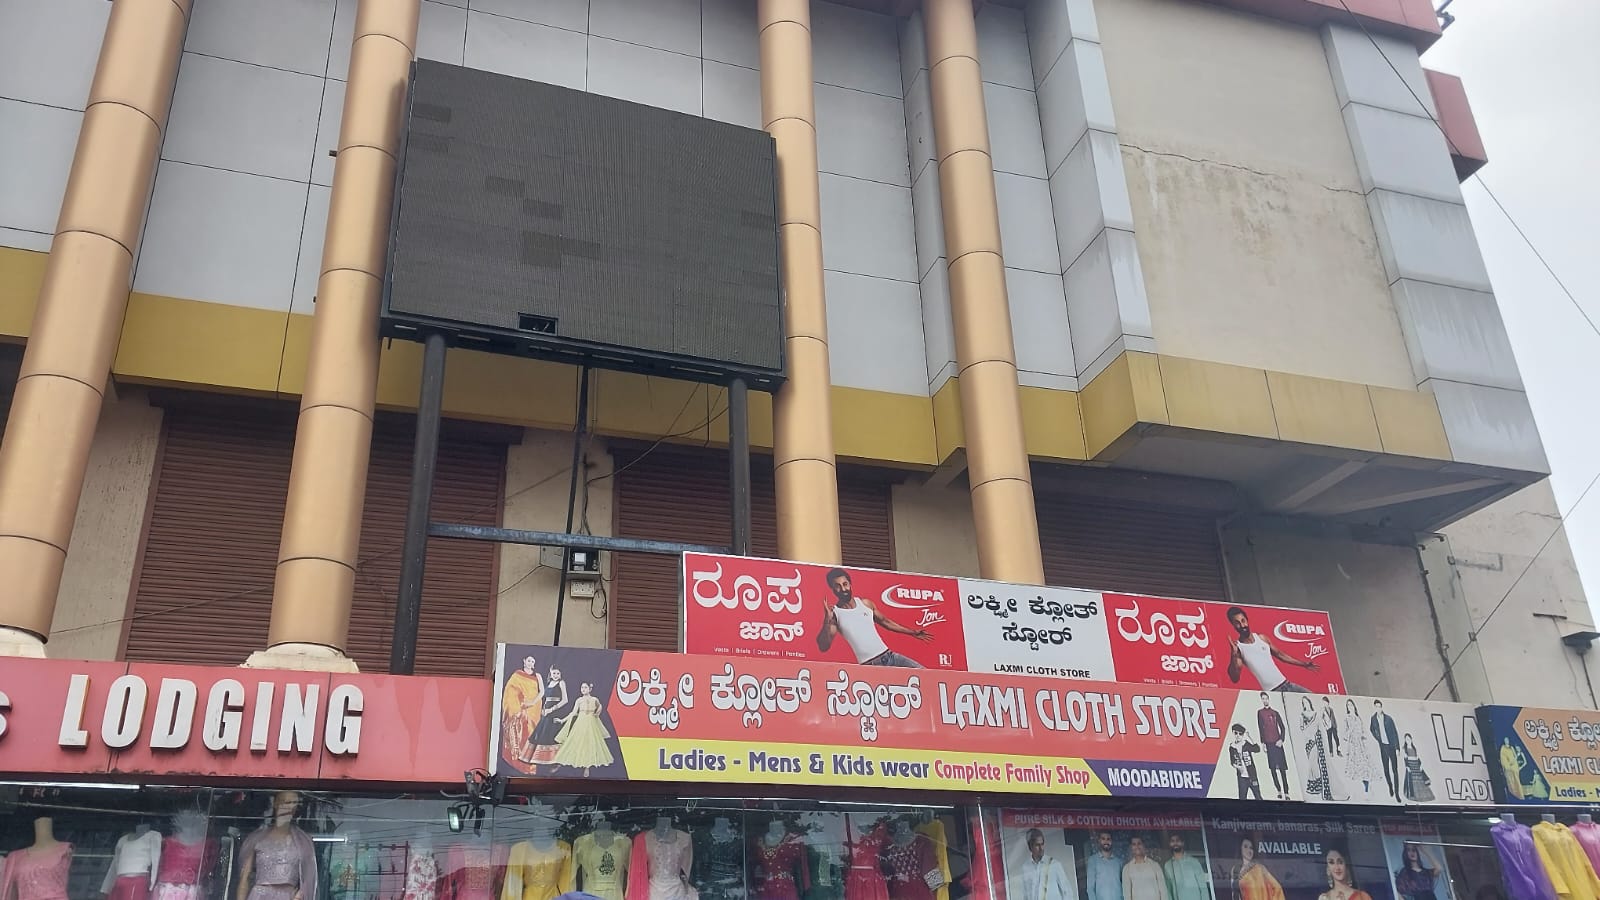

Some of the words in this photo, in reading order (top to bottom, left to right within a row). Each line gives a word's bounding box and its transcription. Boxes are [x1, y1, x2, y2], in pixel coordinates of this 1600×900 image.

[692, 561, 803, 614] ರೂಪ
[896, 587, 945, 602] RUPA
[915, 609, 947, 627] Jon
[967, 593, 1018, 621] ಲಕ್ಷ್ಮೀ
[1028, 595, 1098, 623] ಕ್ಲೋತ್
[739, 620, 805, 642] ಜಾನ್
[1114, 599, 1209, 649] ರೂಪ
[1285, 622, 1325, 636] RUPA
[1002, 621, 1073, 651] ಸ್ಟೋರ್
[1304, 642, 1329, 659] Jon
[993, 663, 1024, 673] LAXMI
[1026, 665, 1058, 676] CLOTH
[1060, 668, 1091, 679] STORE
[1160, 653, 1214, 675] ಜಾನ್
[616, 667, 695, 731] ಲಕ್ಷ್ಮೀ
[710, 663, 812, 728] ಕ್ಲೋತ್
[826, 668, 922, 741] ಸ್ಟೋರ್
[938, 682, 1029, 730] LAXMI
[1035, 689, 1126, 738] CLOTH
[1131, 695, 1221, 742] STORE
[58, 673, 365, 755] LODGING
[659, 748, 726, 771] Ladies
[749, 751, 801, 773] Mens
[808, 753, 824, 774] &
[833, 754, 874, 776] Kids
[880, 761, 929, 779] wear
[934, 759, 1000, 785] Complete
[1005, 763, 1052, 787] Family
[1057, 766, 1090, 789] Shop
[1541, 755, 1584, 776] LAXMI
[1107, 767, 1202, 789] MOODABIDRE
[1555, 786, 1587, 798] Ladies
[1014, 814, 1040, 824] PURE
[1041, 815, 1064, 825] SILK
[1067, 816, 1074, 825] &
[1076, 816, 1114, 826] COTTON
[1346, 821, 1376, 835] Saree
[1257, 840, 1322, 855] AVAILABLE
